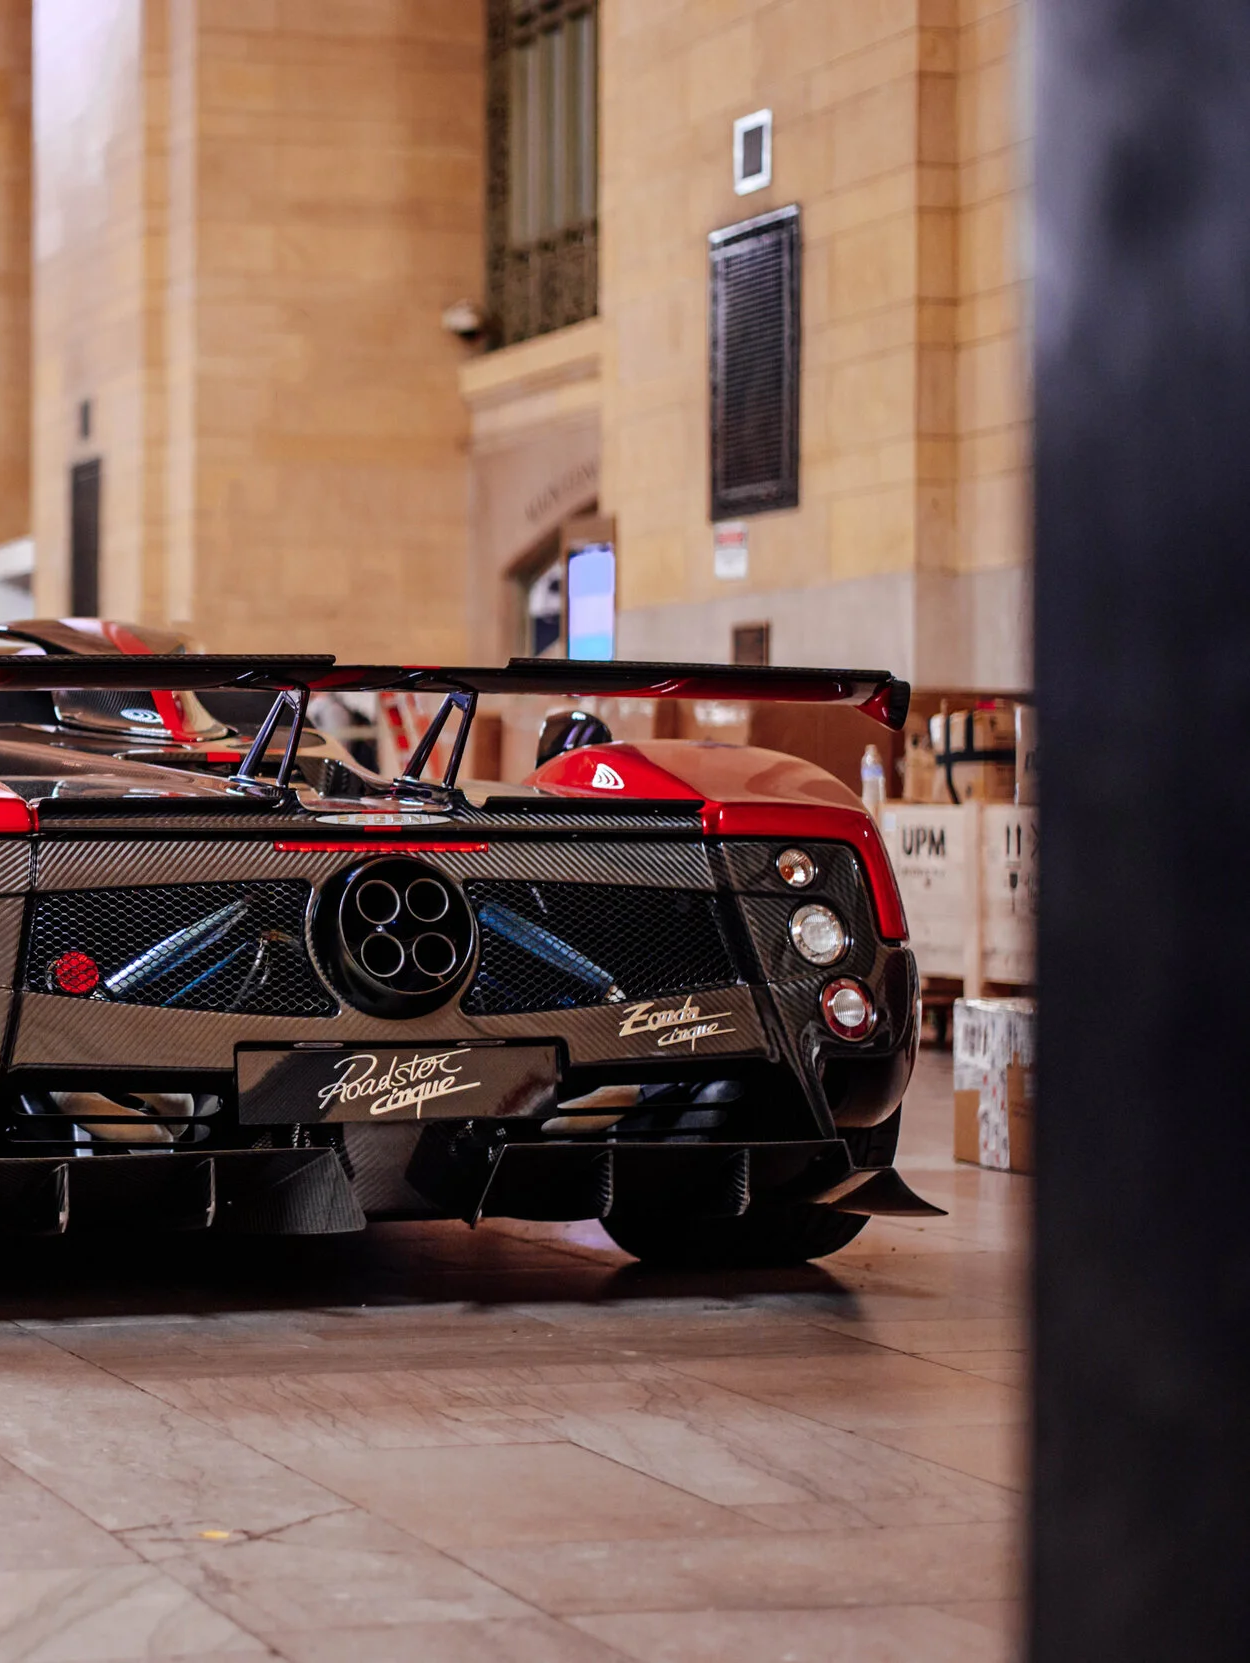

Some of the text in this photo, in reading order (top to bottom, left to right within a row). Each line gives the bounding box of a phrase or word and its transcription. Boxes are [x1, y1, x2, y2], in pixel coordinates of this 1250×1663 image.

[337, 814, 431, 825] PAGANI
[902, 826, 946, 856] UPM
[619, 995, 732, 1037] Zonda
[318, 1049, 471, 1109] Roadster
